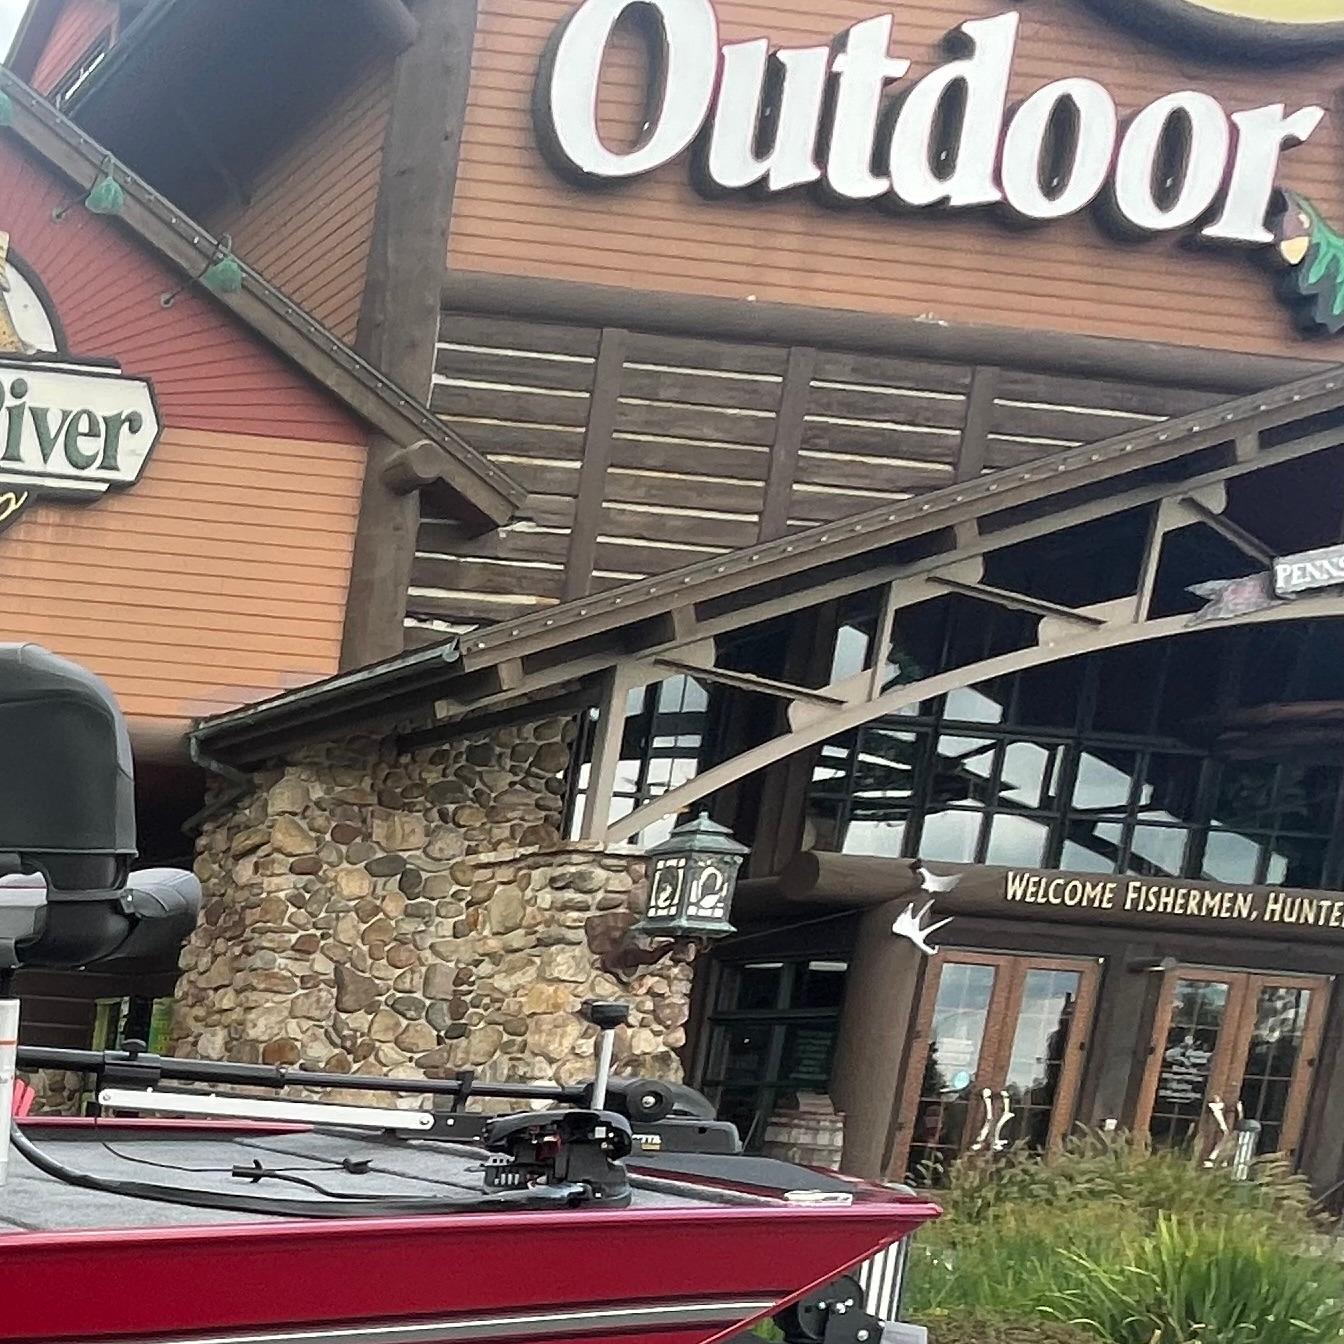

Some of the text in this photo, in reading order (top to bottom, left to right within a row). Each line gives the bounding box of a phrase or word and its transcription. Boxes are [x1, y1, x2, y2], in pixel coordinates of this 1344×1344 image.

[549, 0, 1324, 243] Outdoor
[1005, 871, 1344, 928] WELCOME FISHERMEN, HUNTE
